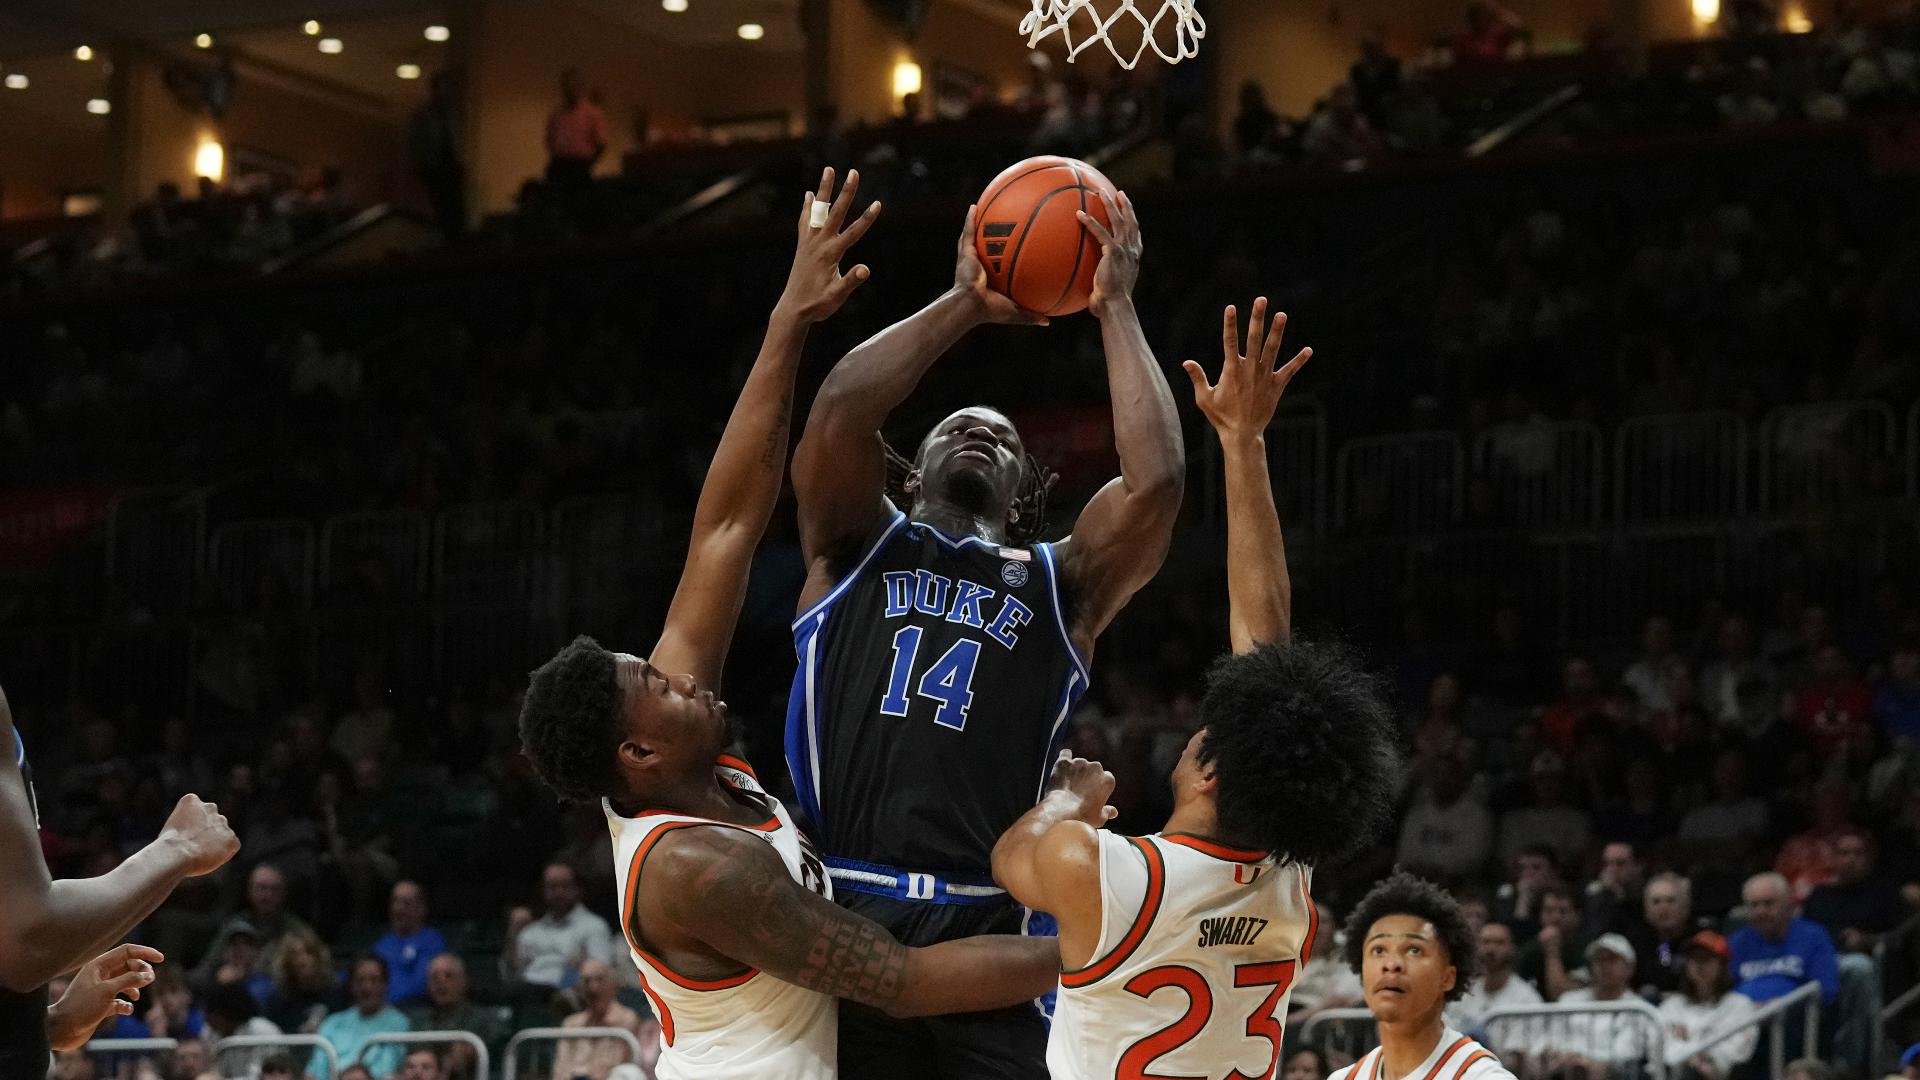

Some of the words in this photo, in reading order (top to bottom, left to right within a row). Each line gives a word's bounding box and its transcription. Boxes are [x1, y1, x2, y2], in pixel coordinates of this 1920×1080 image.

[884, 569, 1034, 650] DUKE
[880, 625, 982, 731] 14
[1198, 916, 1269, 948] SWARTZ
[1116, 959, 1296, 1080] 23
